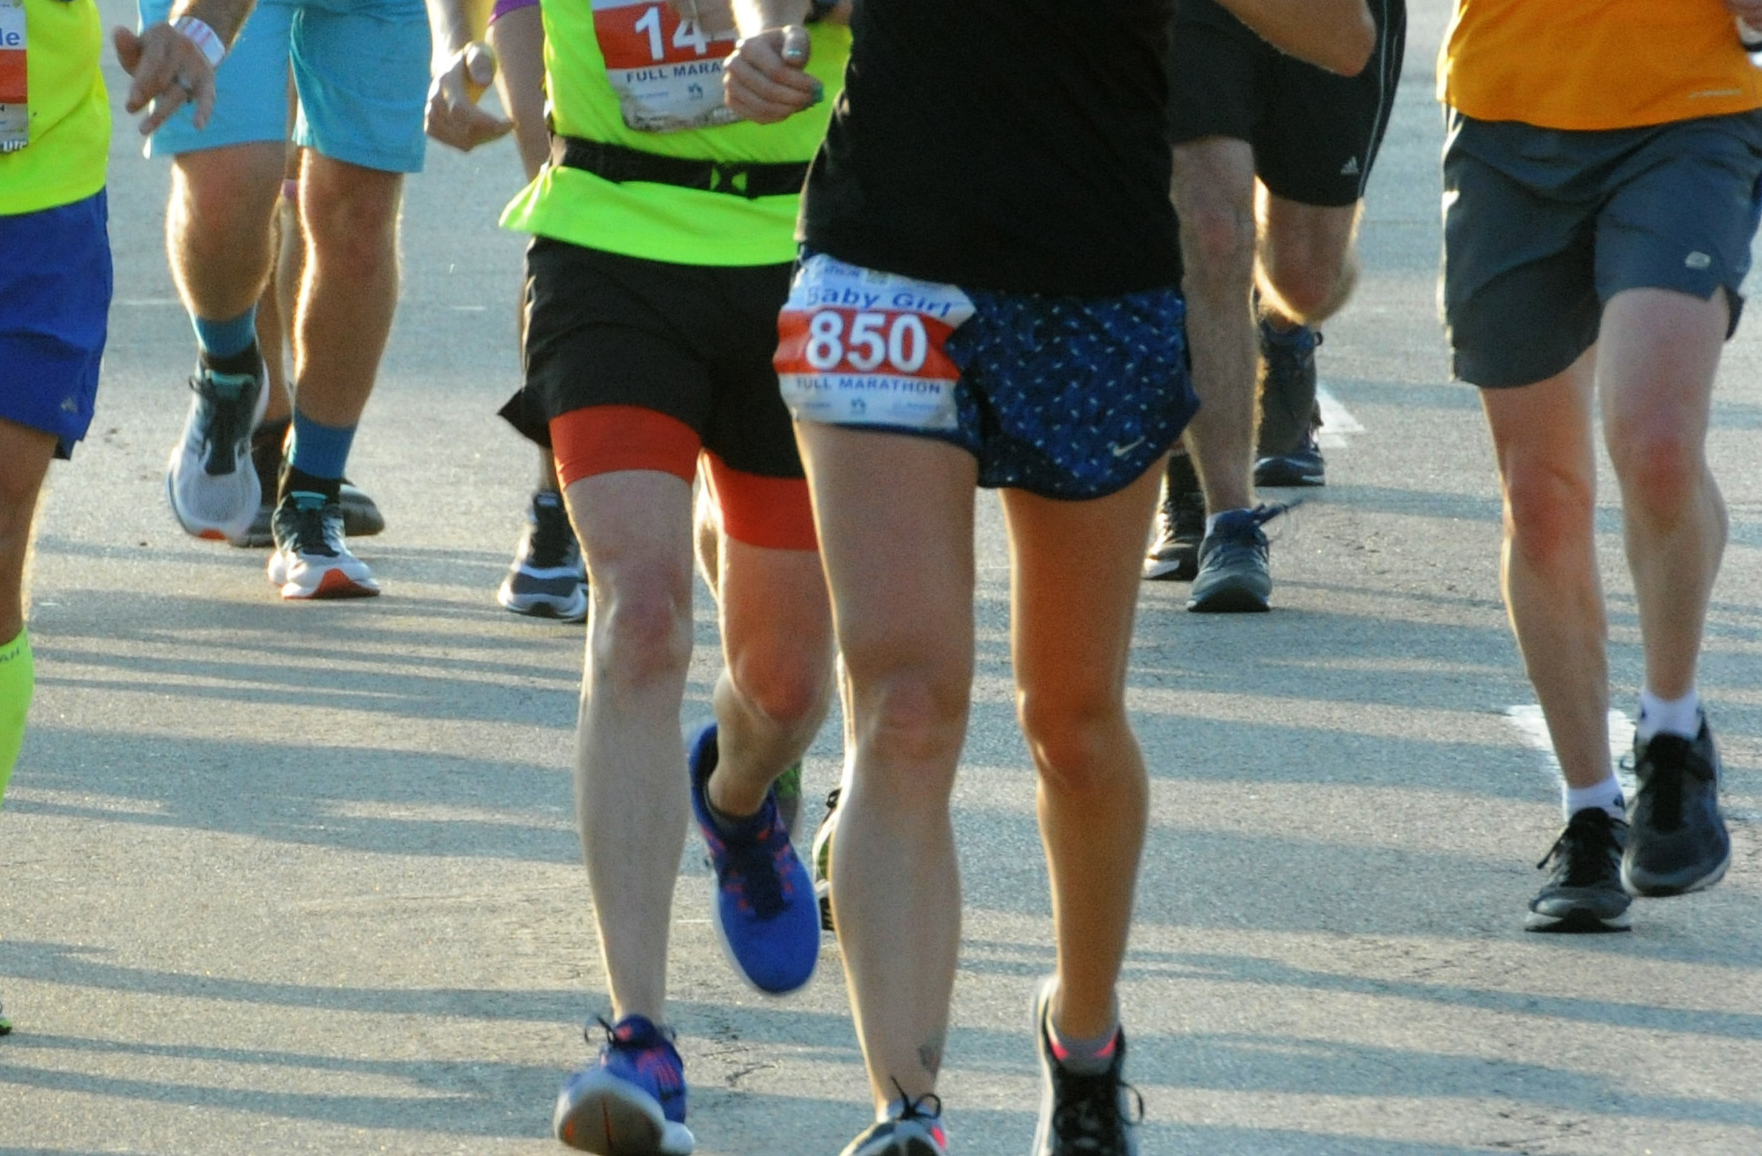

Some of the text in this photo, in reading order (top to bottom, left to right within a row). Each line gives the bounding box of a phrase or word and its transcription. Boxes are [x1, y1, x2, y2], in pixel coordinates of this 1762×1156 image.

[627, 62, 721, 83] FULL MARA
[806, 287, 952, 318] Baby Girl
[805, 310, 928, 374] 850
[796, 377, 941, 394] FULL MARATHON
